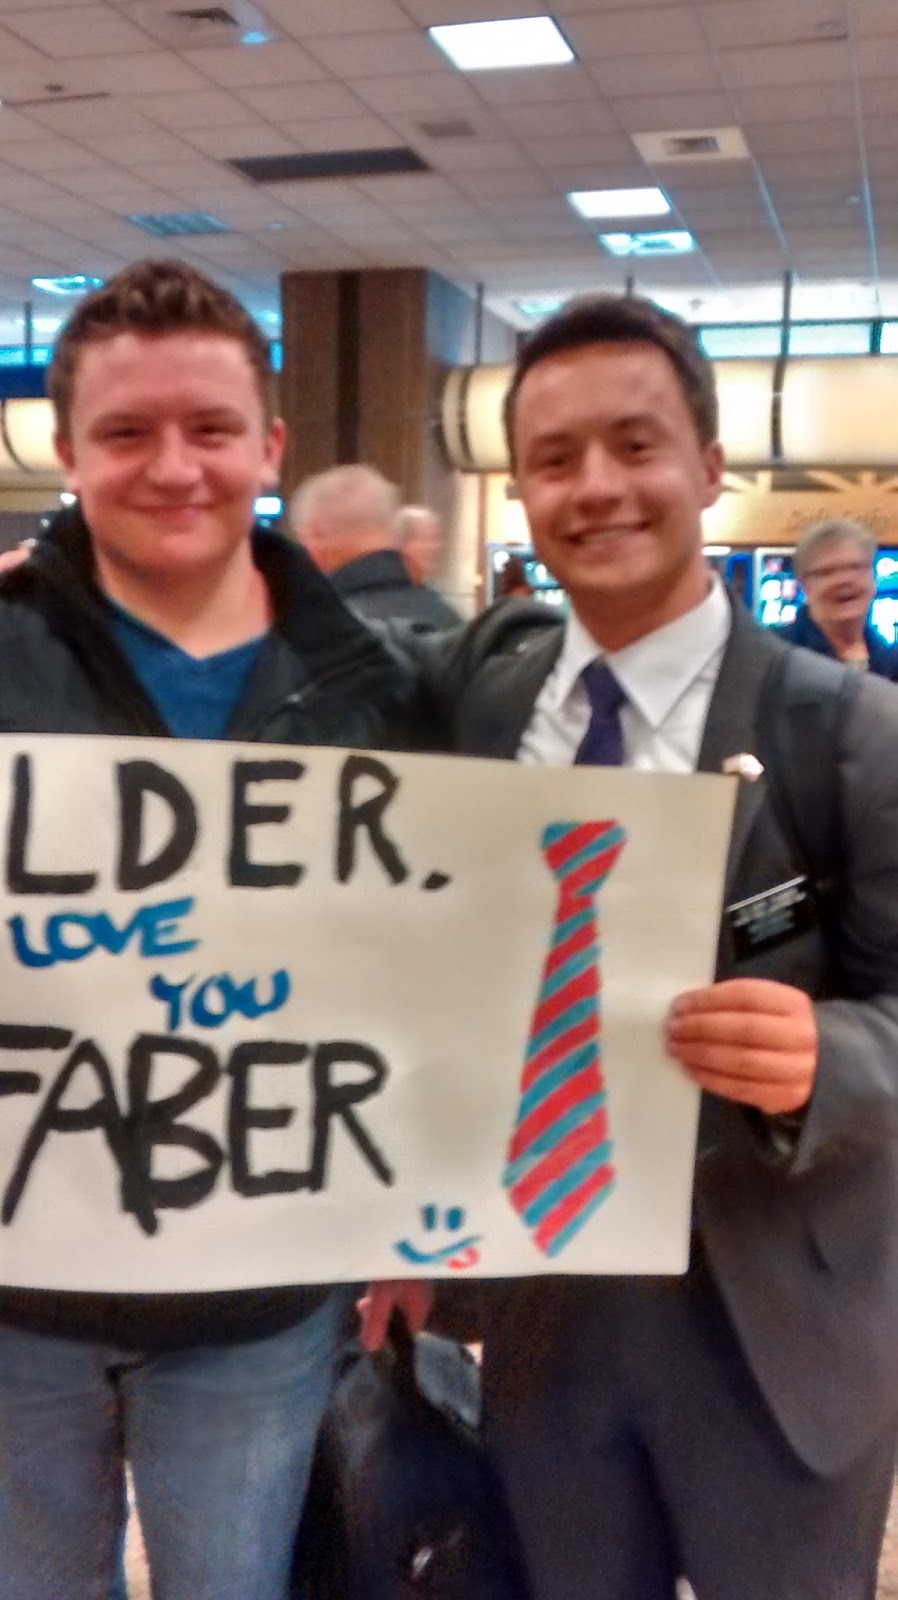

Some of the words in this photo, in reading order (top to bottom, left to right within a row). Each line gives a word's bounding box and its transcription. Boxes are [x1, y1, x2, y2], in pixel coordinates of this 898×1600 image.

[8, 897, 198, 968] LOVE
[149, 969, 290, 1031] YOU
[0, 1023, 394, 1236] FABER
